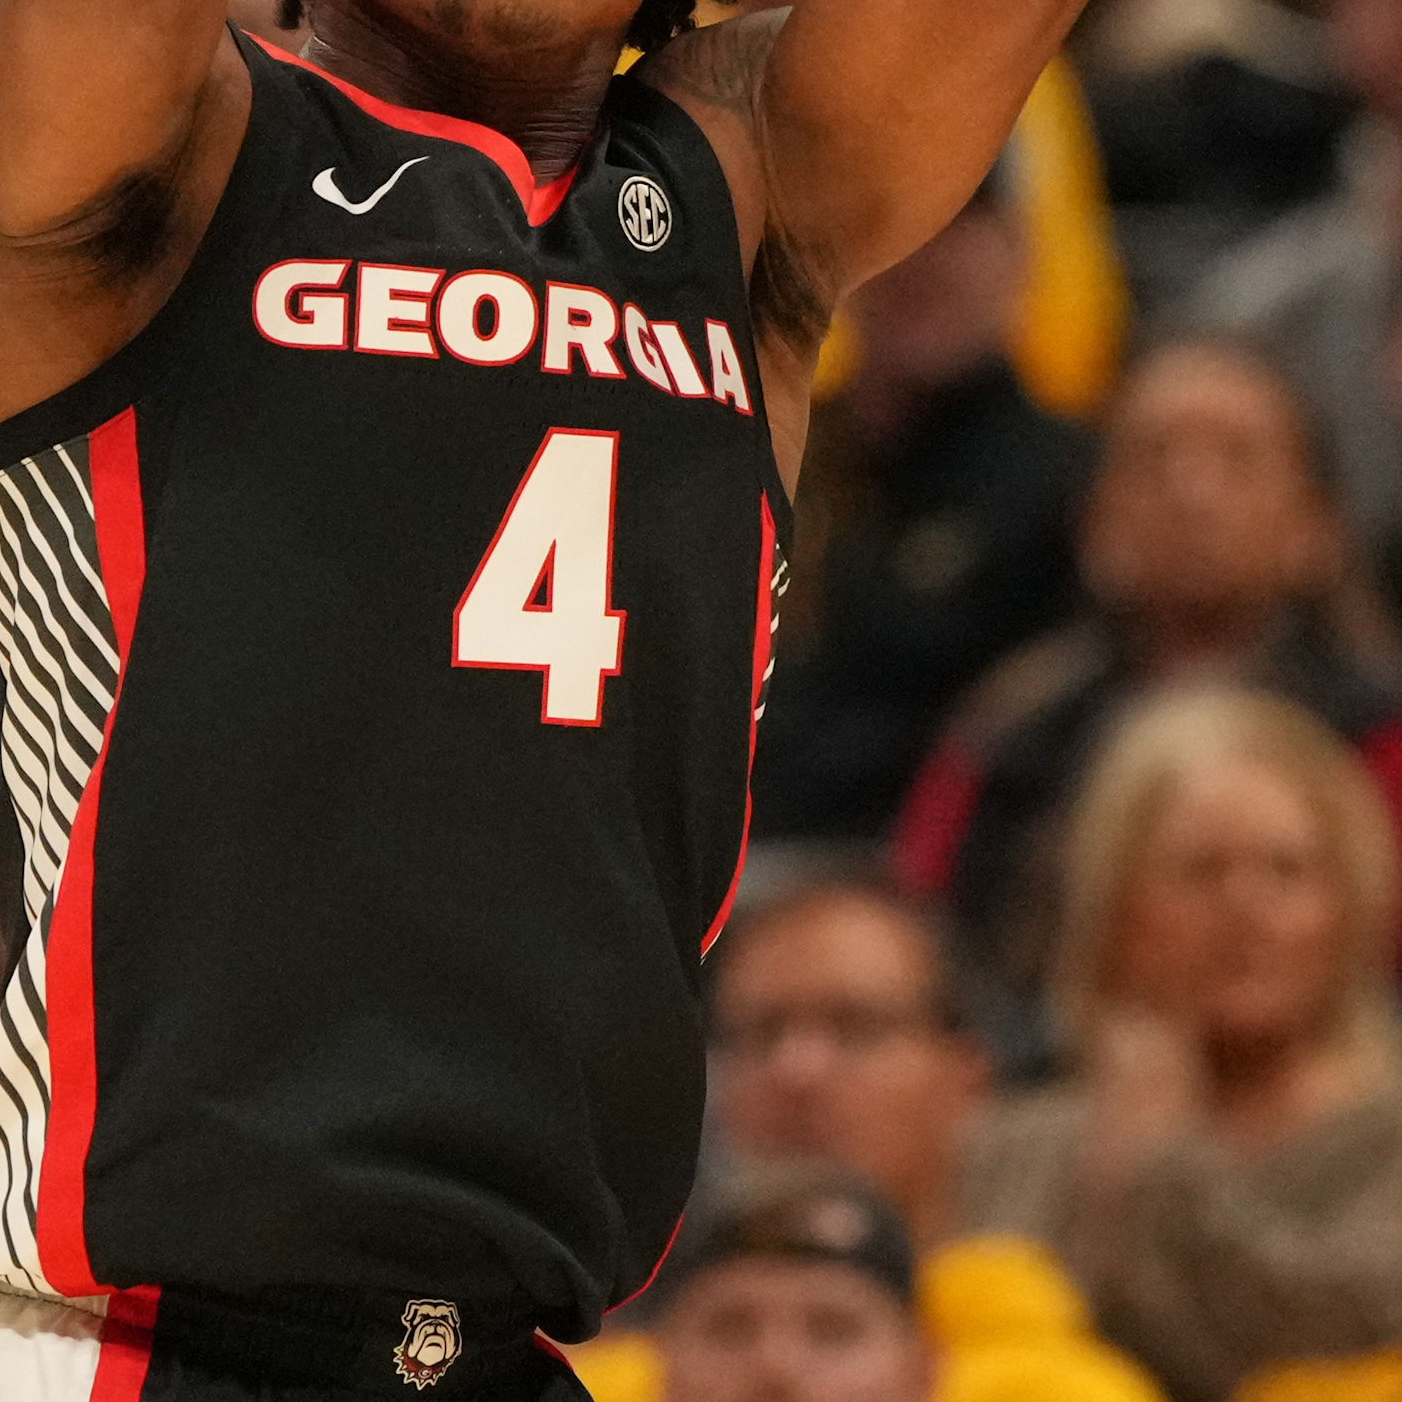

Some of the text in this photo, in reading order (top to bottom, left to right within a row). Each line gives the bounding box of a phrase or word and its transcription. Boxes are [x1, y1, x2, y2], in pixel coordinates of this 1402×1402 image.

[623, 183, 667, 245] SEC
[253, 259, 754, 415] GEORGIA
[451, 427, 627, 726] 4
